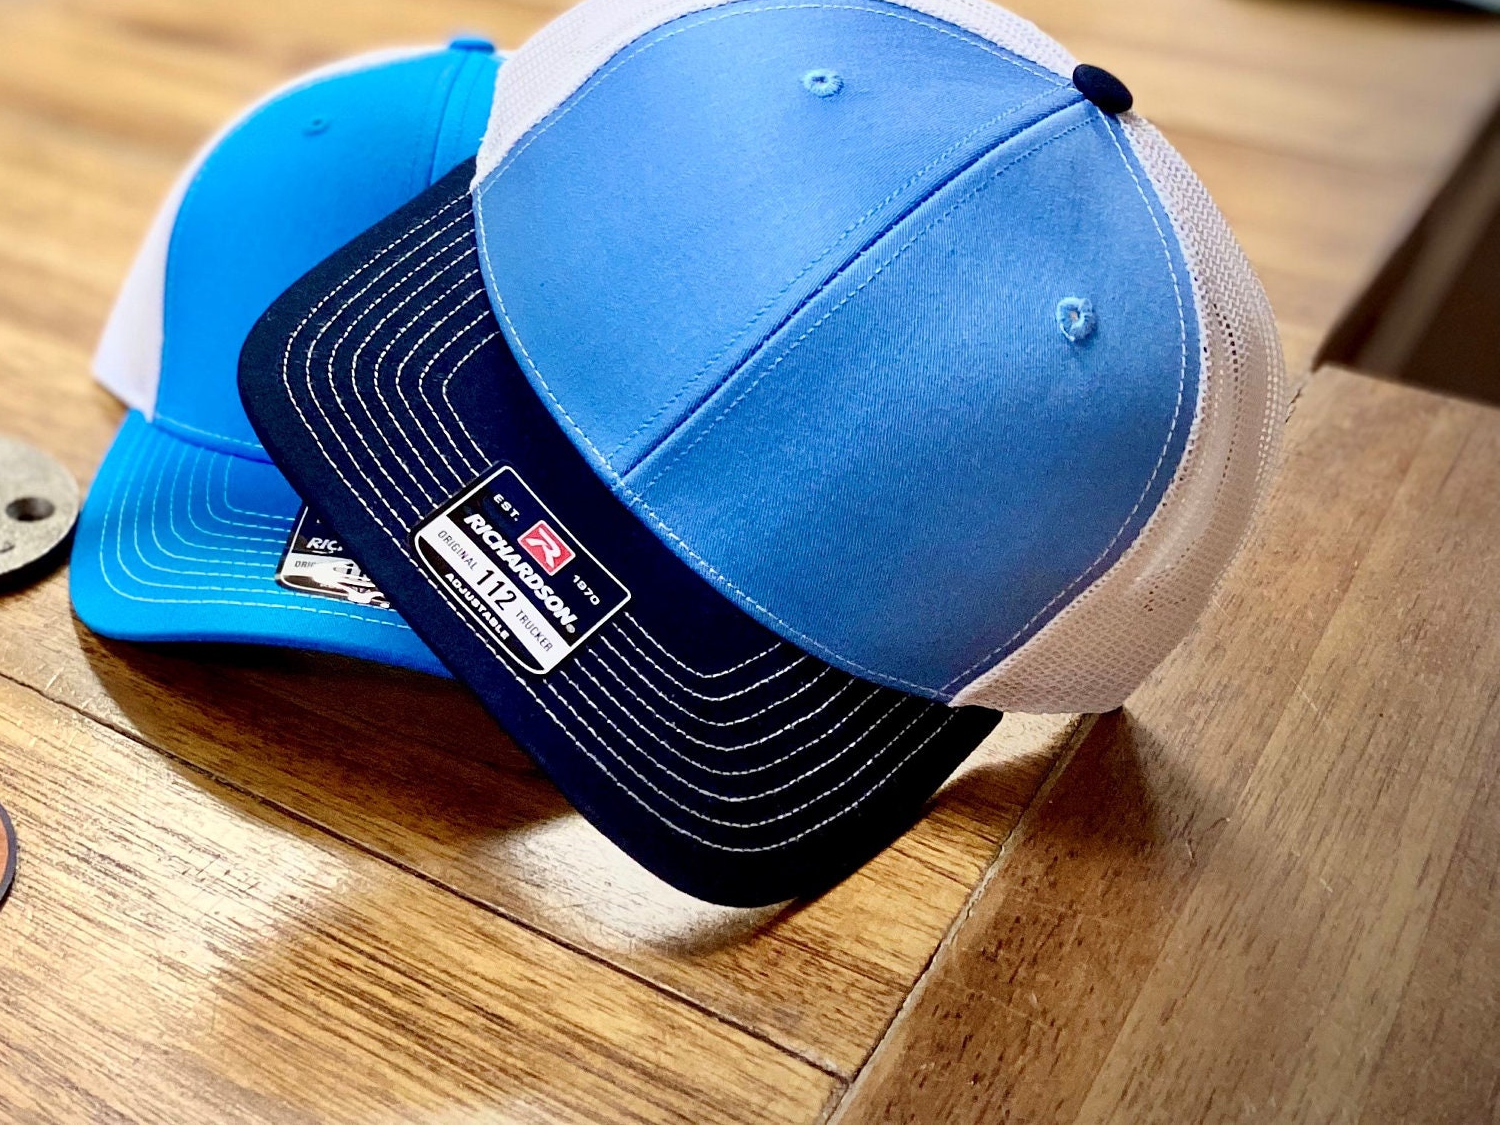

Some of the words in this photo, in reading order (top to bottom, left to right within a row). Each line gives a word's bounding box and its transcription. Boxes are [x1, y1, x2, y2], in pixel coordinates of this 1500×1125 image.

[306, 537, 343, 551] RIC
[437, 530, 478, 571] ORIGINAL
[476, 568, 517, 611] 112
[515, 609, 553, 652] TRUCKER
[463, 513, 579, 626] RICHARDSON
[493, 493, 520, 522] EST.
[572, 574, 601, 606] 1970
[444, 572, 510, 640] ADJUSTABLE
